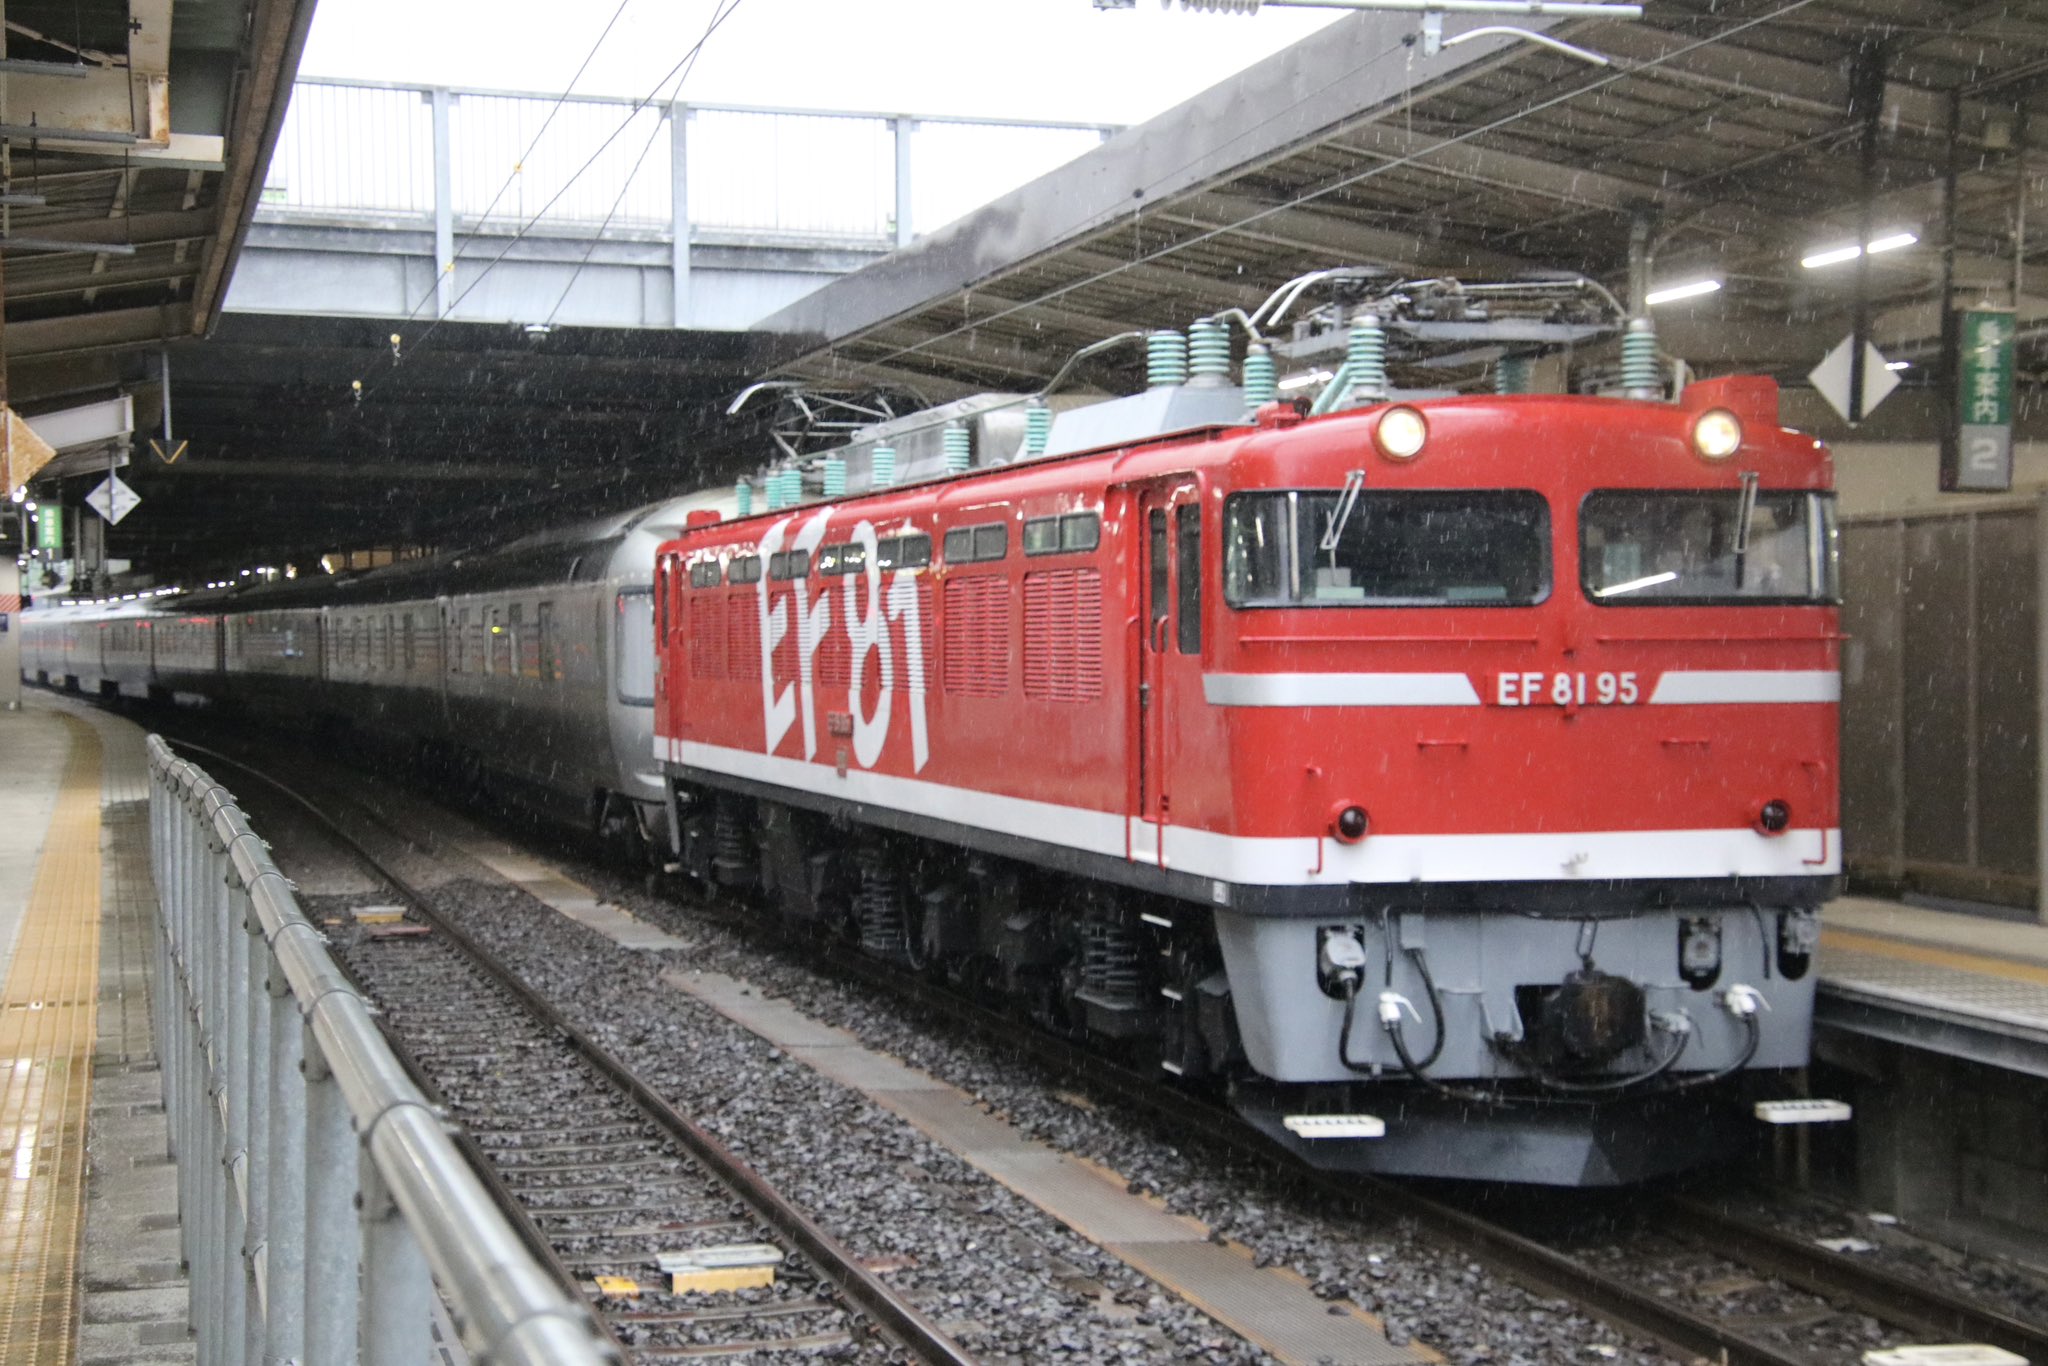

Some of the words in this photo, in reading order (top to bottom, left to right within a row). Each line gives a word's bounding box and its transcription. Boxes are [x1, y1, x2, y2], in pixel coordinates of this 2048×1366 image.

[1970, 436, 1999, 471] 2
[756, 506, 929, 774] EF81
[1497, 672, 1544, 705] EF
[1552, 672, 1586, 705] 81
[1596, 671, 1639, 705] 95
